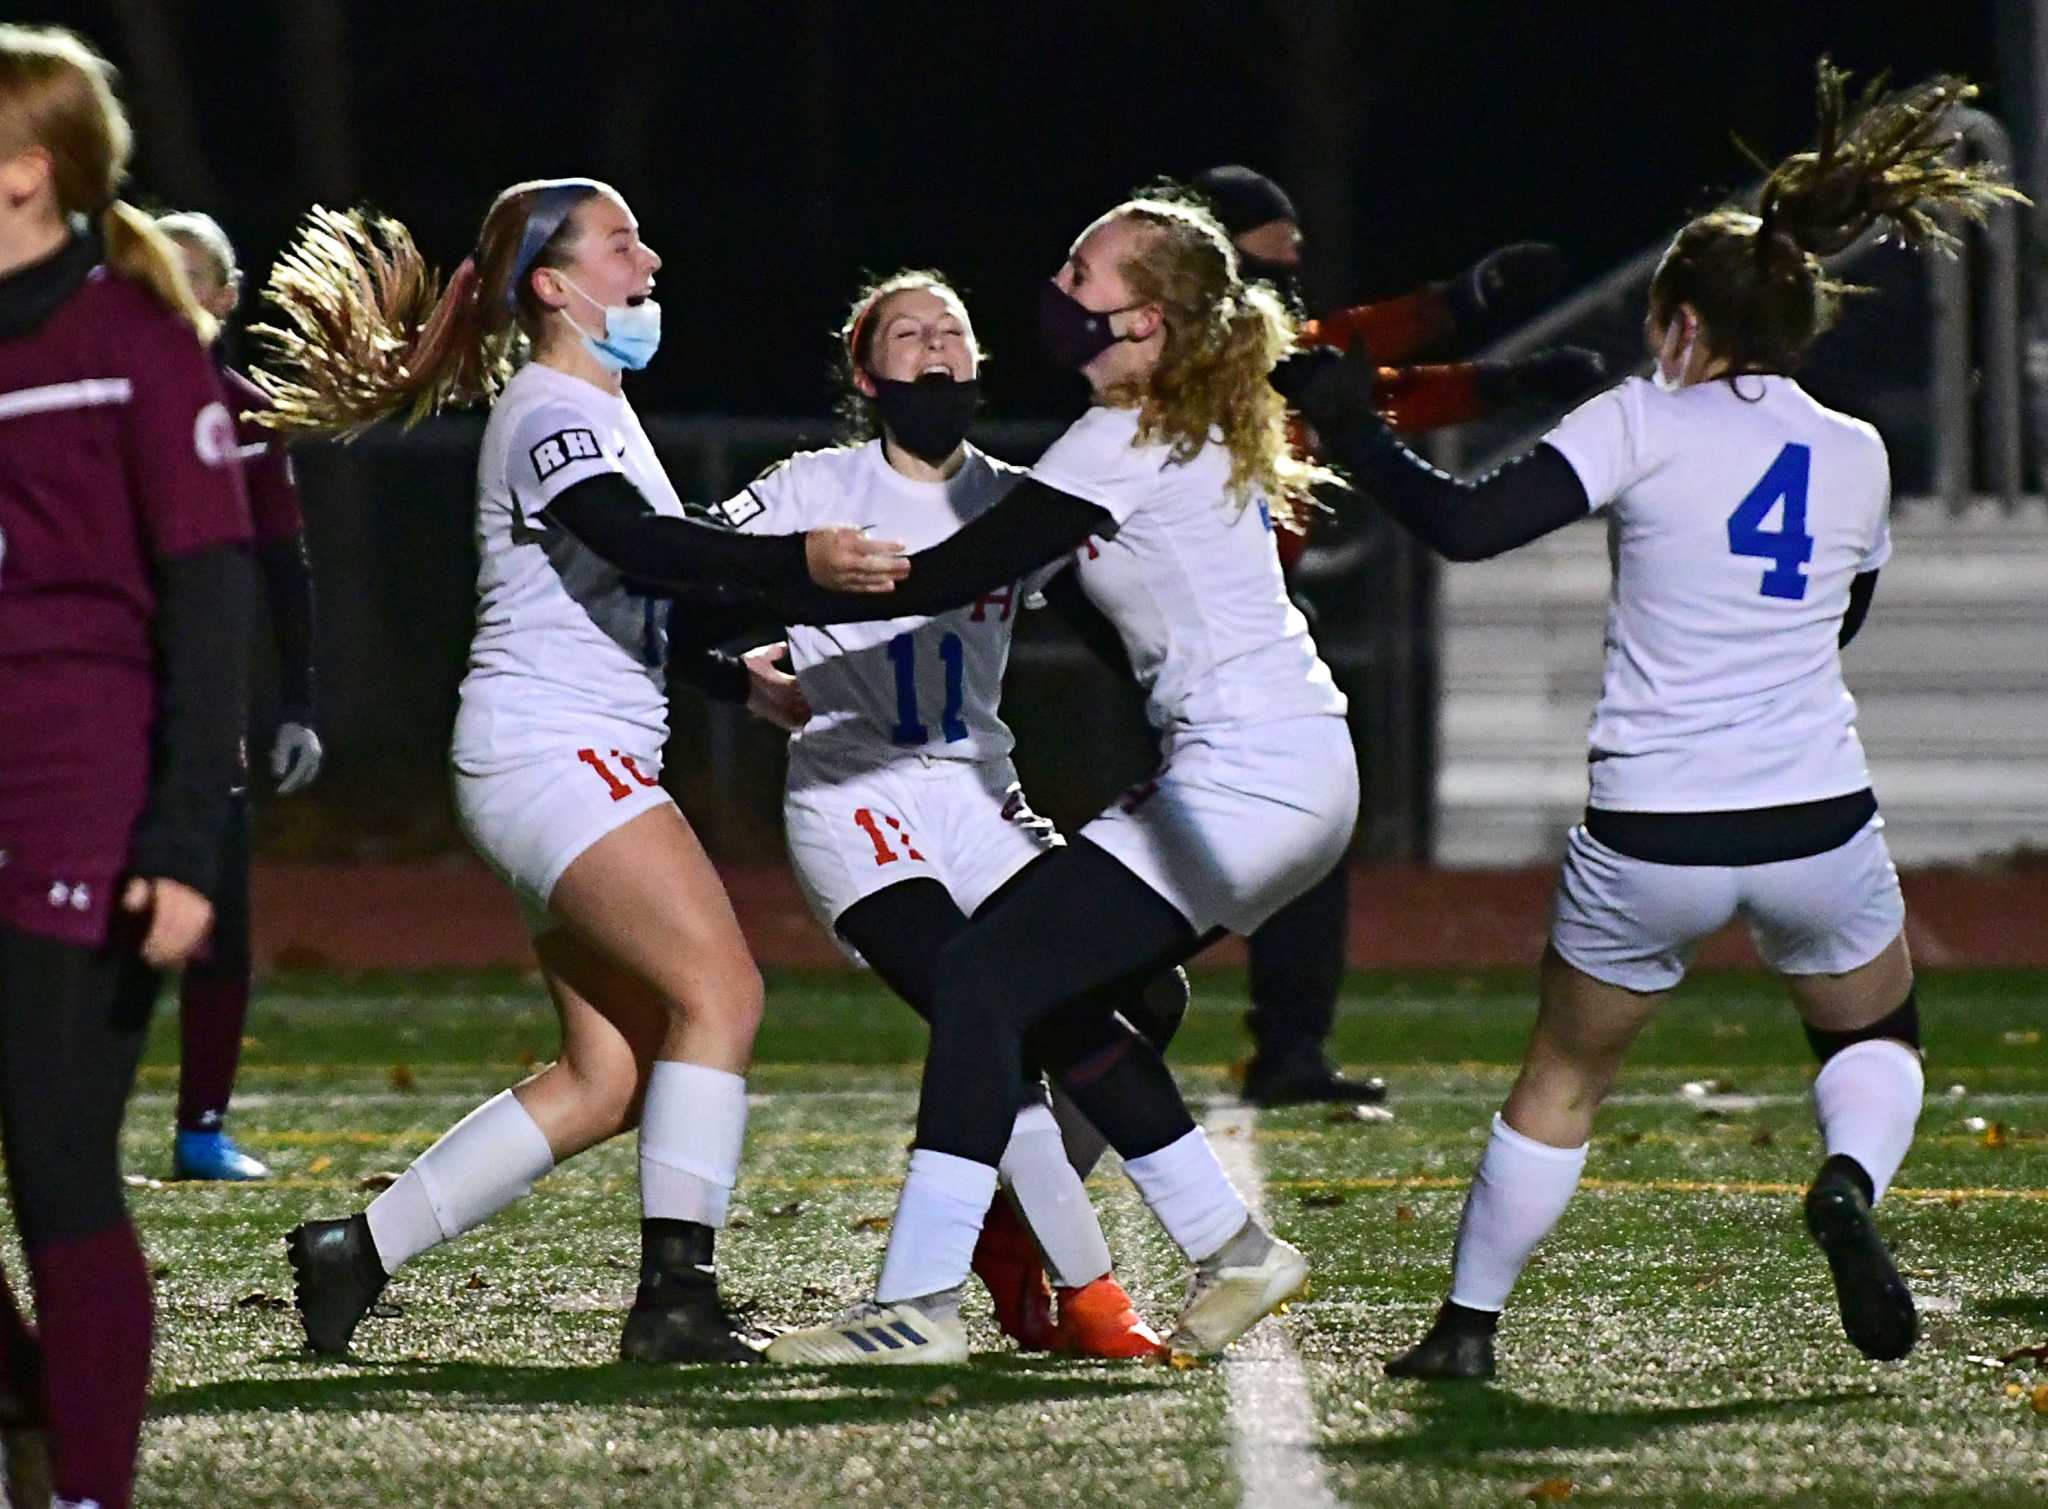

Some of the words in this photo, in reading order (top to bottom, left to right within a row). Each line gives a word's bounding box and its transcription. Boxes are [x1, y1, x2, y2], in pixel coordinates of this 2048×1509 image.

[529, 428, 603, 482] RH
[1727, 442, 1814, 600] 4
[887, 632, 968, 745] 11
